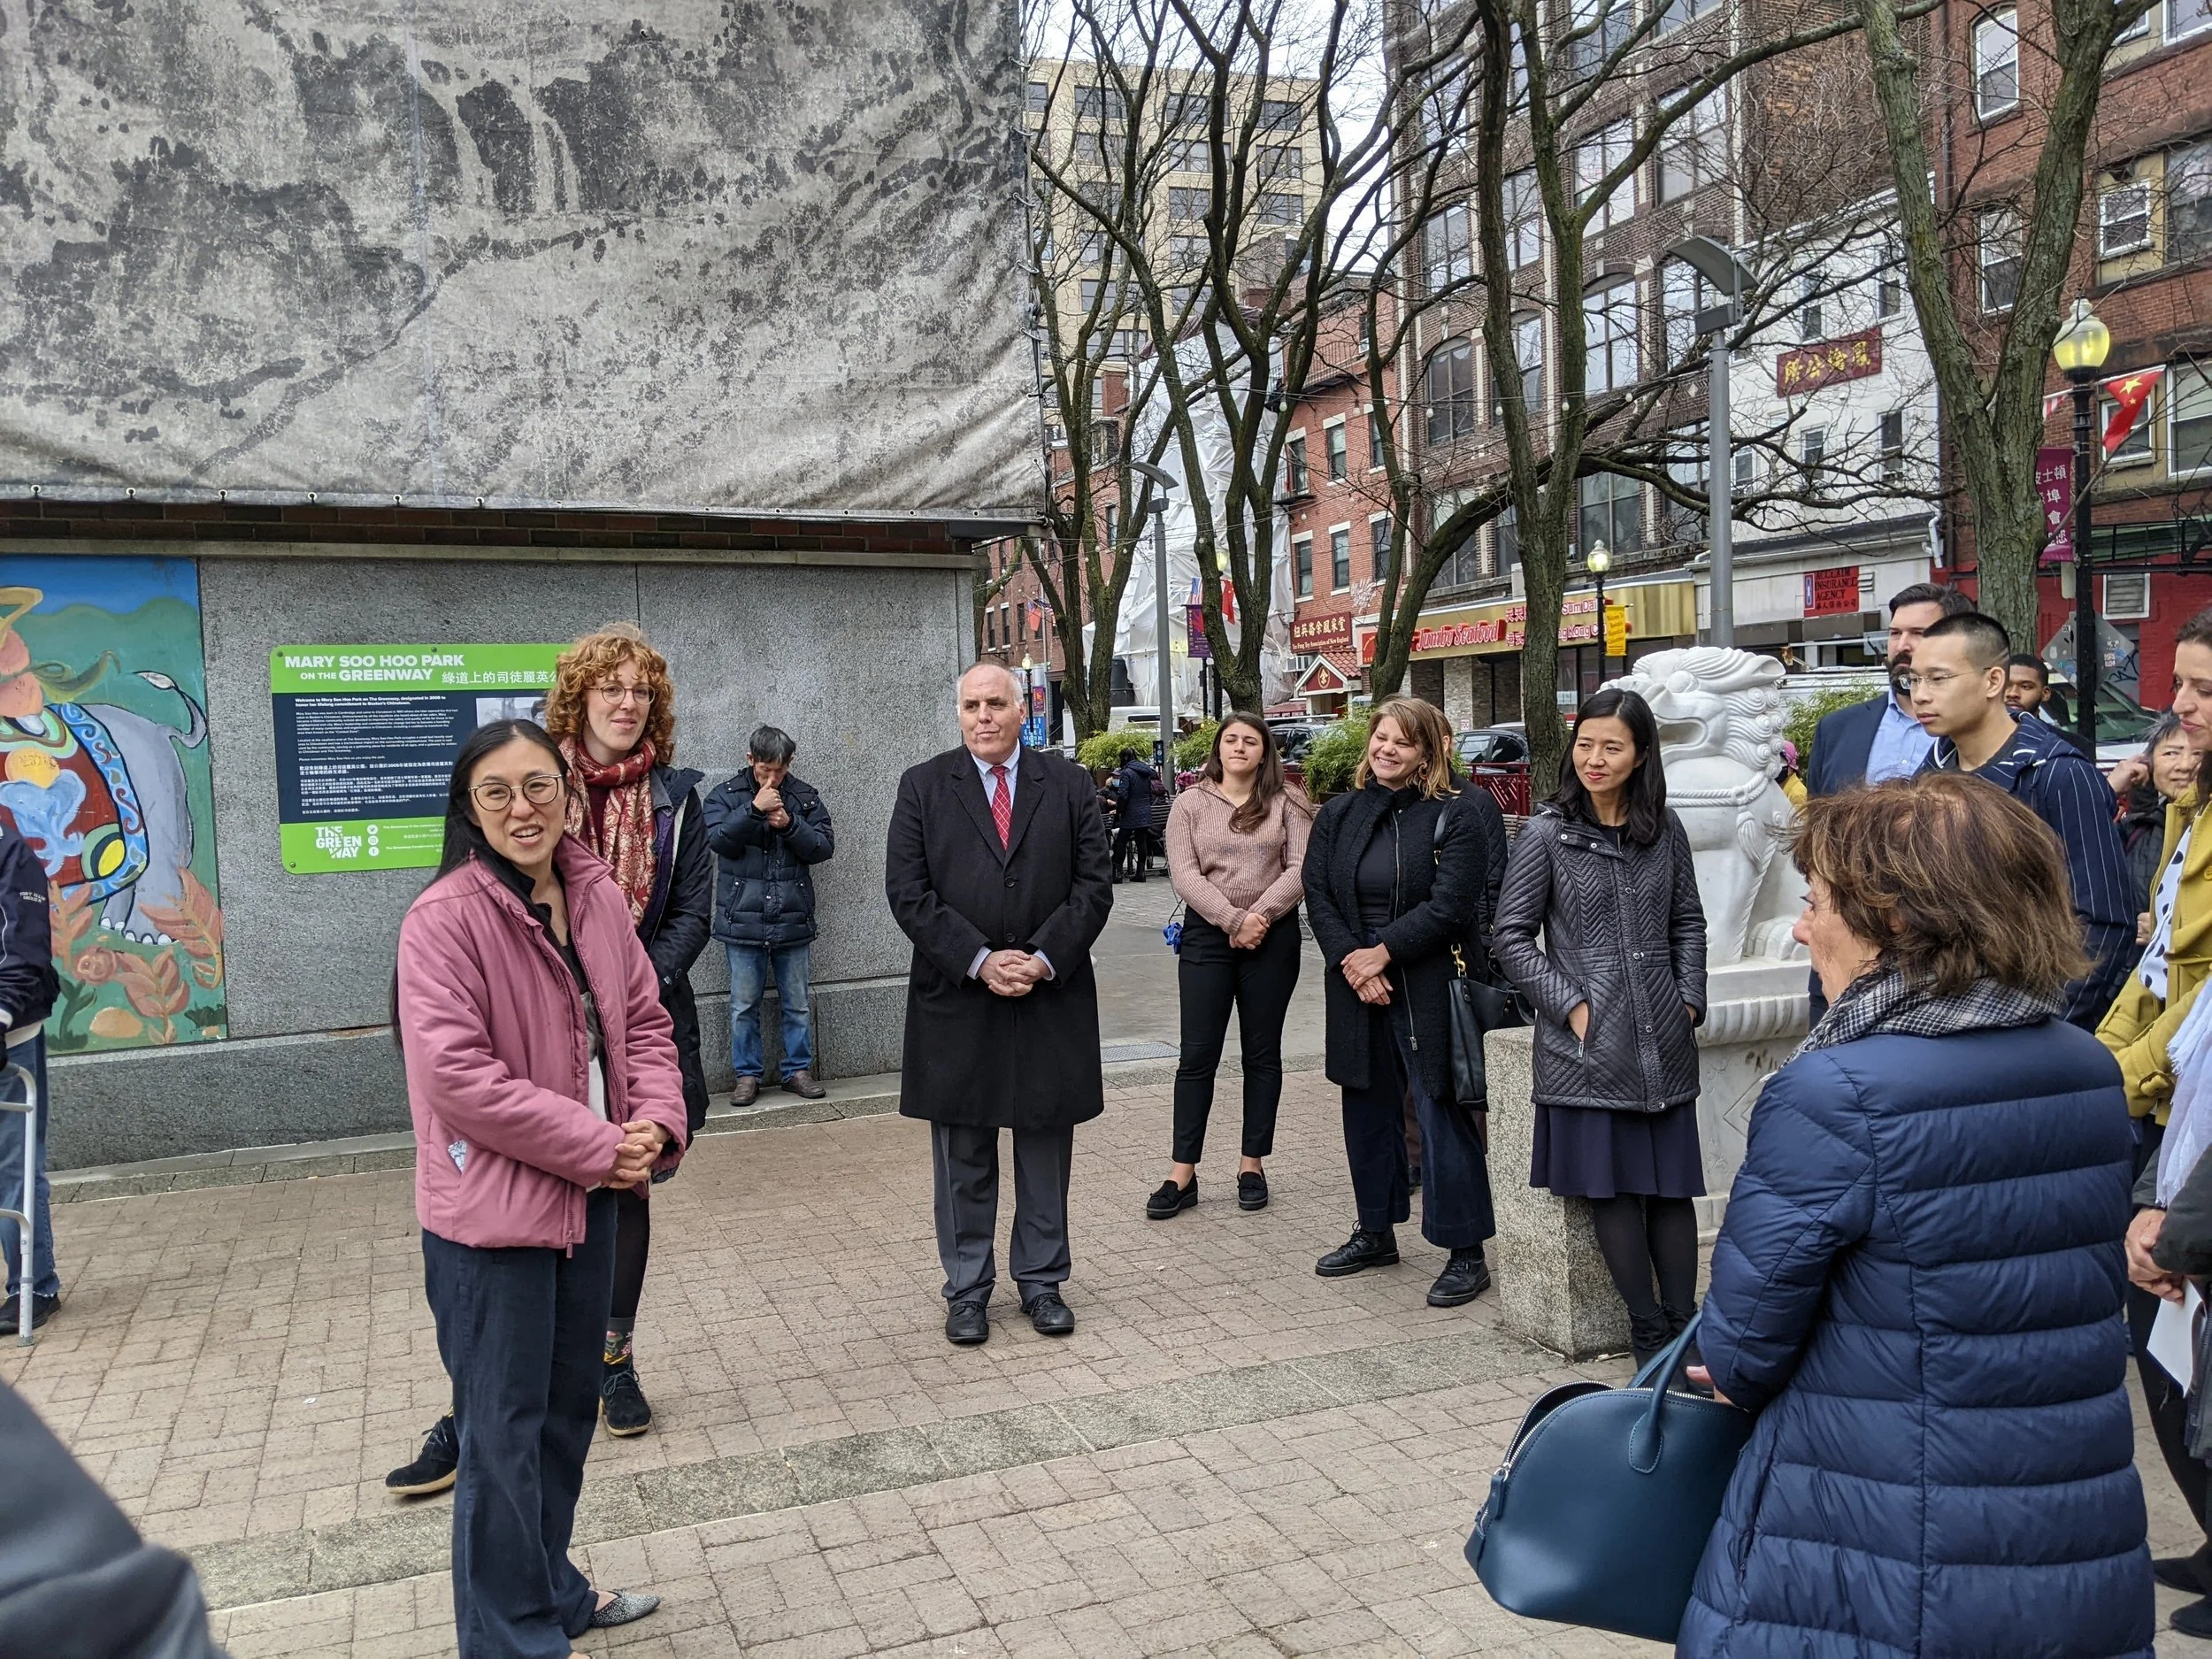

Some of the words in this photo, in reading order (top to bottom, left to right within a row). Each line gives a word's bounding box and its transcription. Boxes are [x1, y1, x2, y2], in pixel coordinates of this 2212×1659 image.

[2039, 488, 2061, 504] 埠
[1815, 567, 1851, 581] ACCLAIM
[1815, 577, 1858, 591] INSURANCE
[1816, 589, 1846, 601] AGENCY
[1505, 606, 1528, 623] 天天
[1562, 602, 1582, 615] Sum
[1416, 628, 1453, 652] Jumbo
[1453, 620, 1499, 645] Seafood
[1567, 624, 1590, 639] Kong
[284, 656, 335, 668] MARY
[339, 655, 376, 667] SOO
[380, 655, 418, 667] HOO
[421, 654, 465, 666] PARK
[339, 668, 433, 681] GREENWAY
[315, 826, 343, 837] THE
[315, 836, 362, 849] GREEN
[329, 847, 359, 859] WAY
